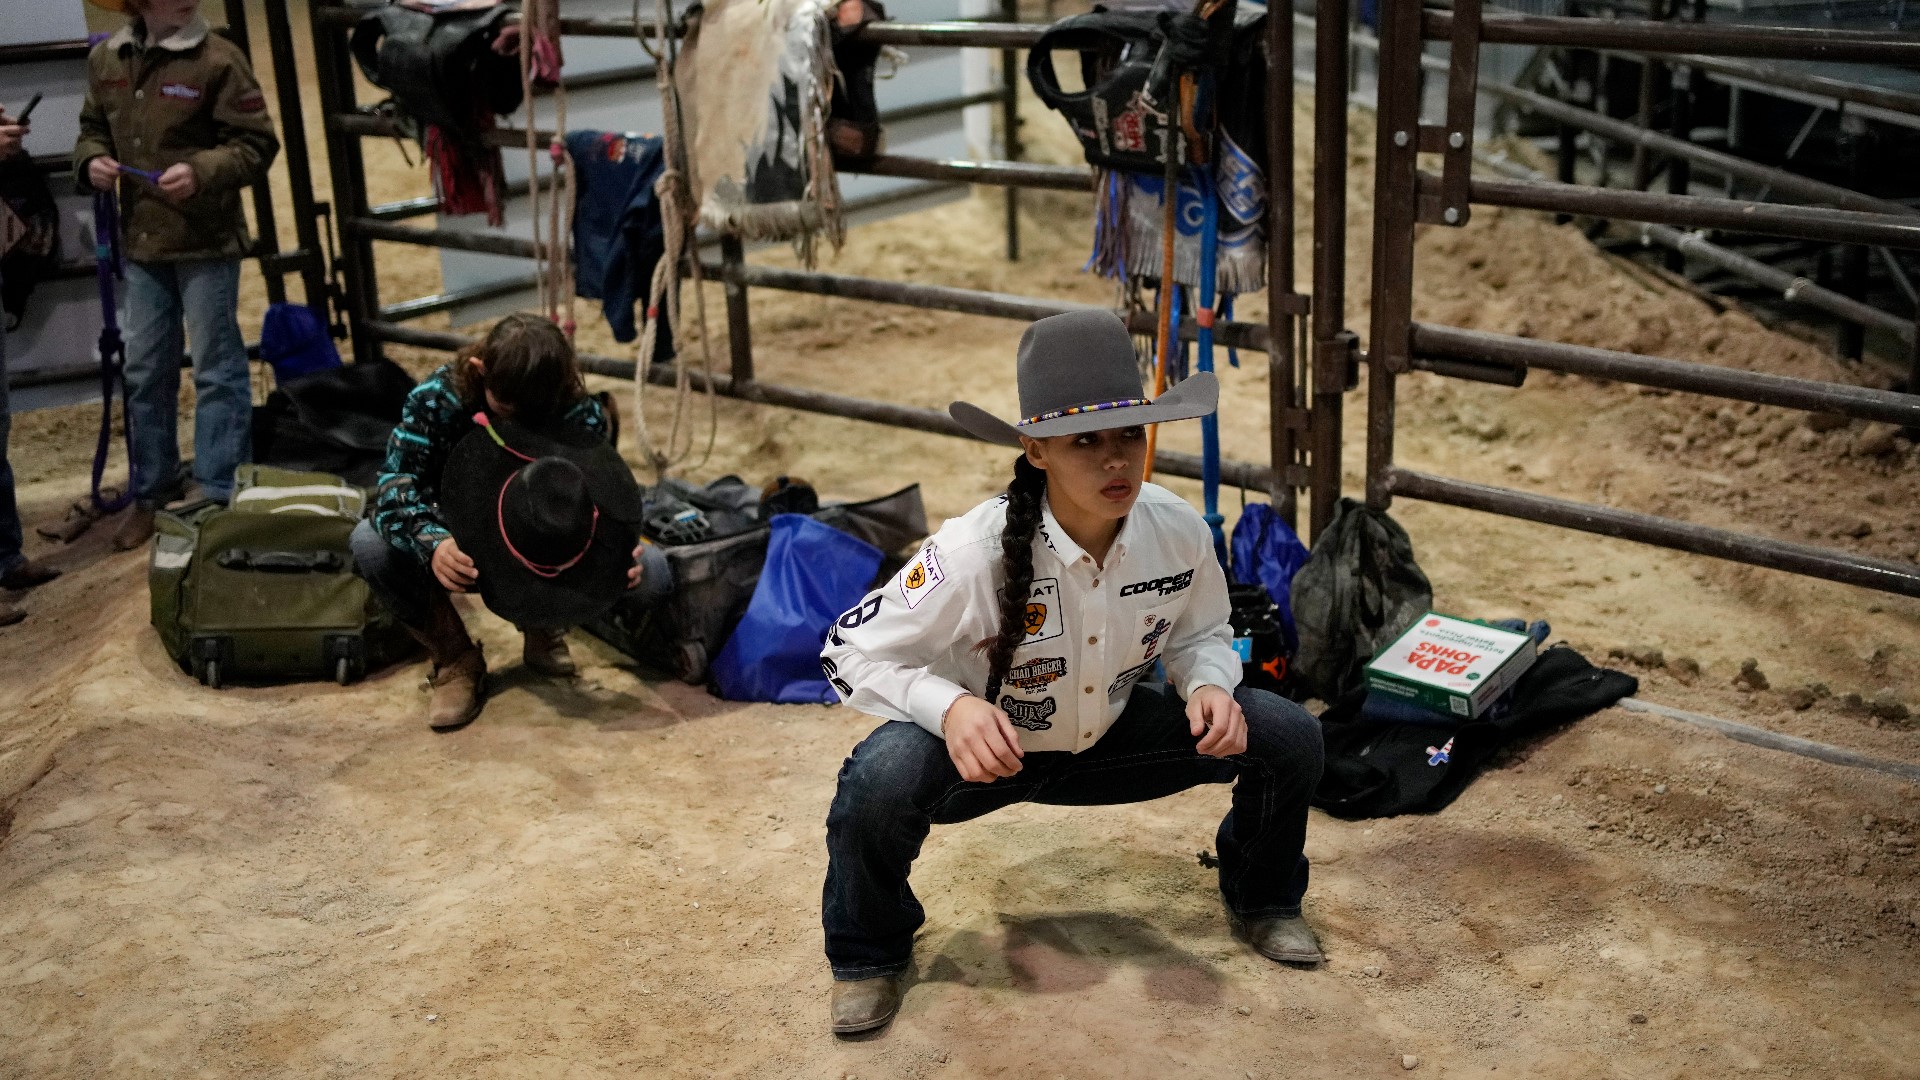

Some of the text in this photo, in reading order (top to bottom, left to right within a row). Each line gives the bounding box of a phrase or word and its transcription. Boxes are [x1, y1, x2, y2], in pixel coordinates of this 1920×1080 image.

[925, 548, 940, 582] ARIAT
[1119, 569, 1195, 597] COOPER
[1157, 580, 1192, 597] TIRES
[1407, 651, 1469, 675] PAPA
[1415, 641, 1482, 664] JOHNS
[1009, 660, 1062, 680] CHAD BERGER
